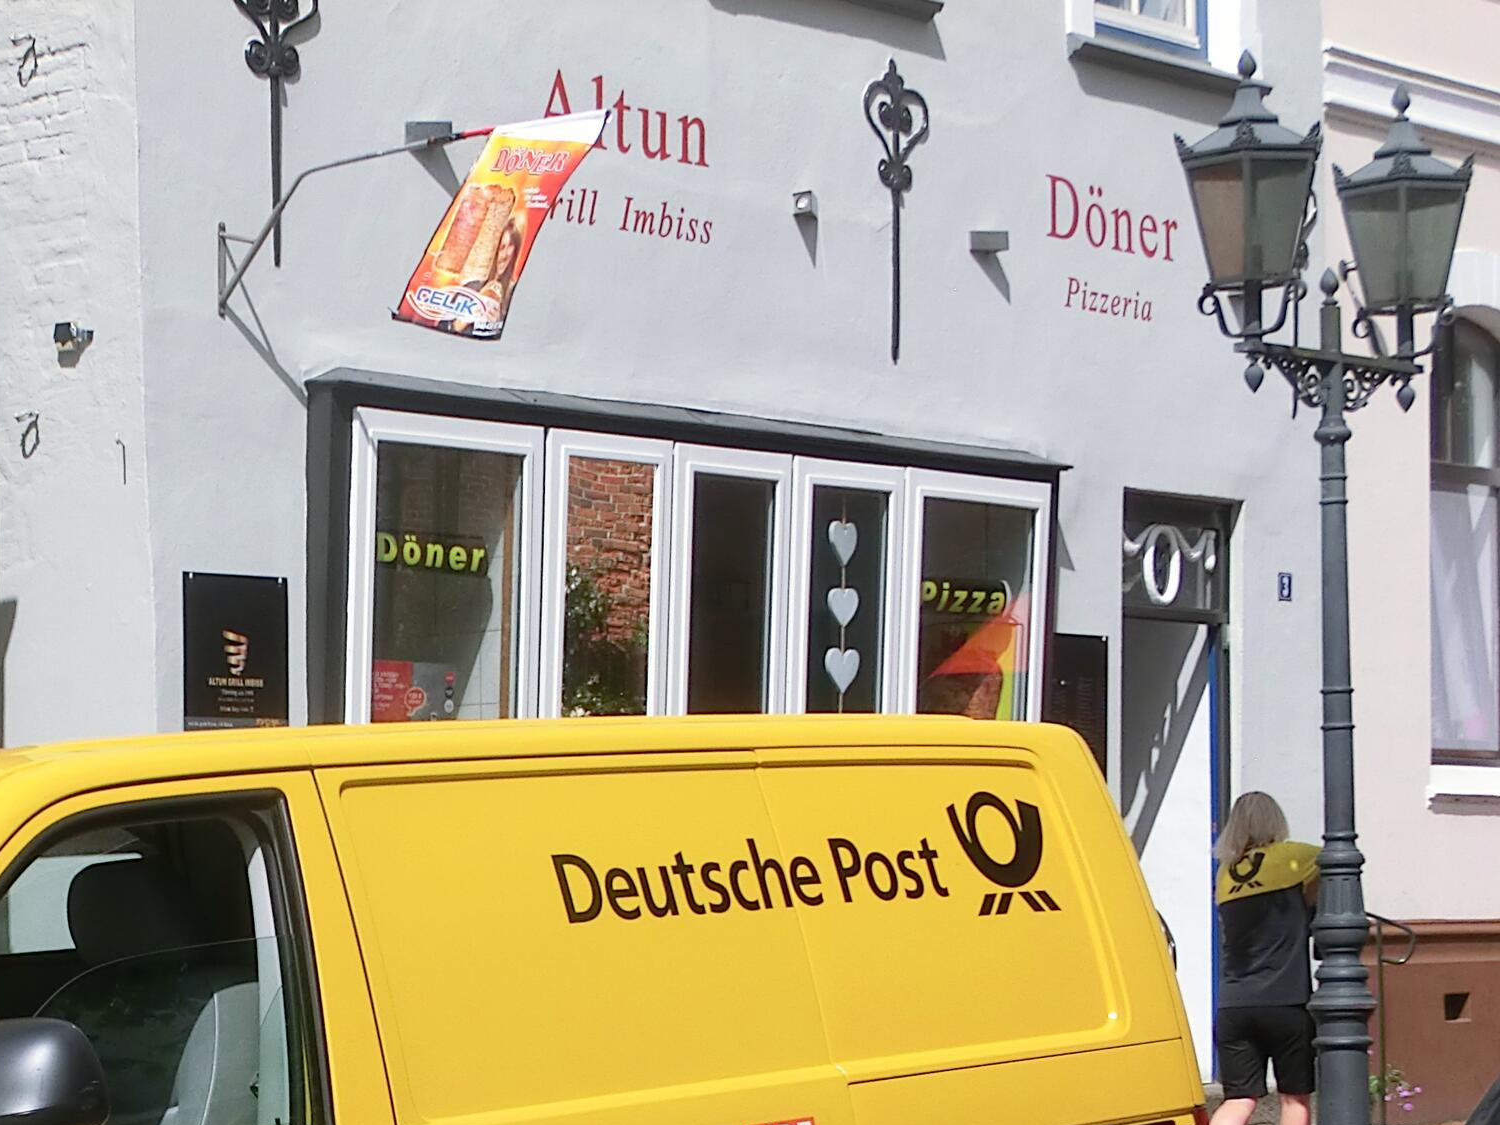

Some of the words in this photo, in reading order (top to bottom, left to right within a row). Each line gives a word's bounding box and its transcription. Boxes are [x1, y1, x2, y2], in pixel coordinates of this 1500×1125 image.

[544, 68, 709, 168] Altun
[550, 188, 598, 226] rill
[619, 196, 713, 245] Imbiss
[1045, 173, 1179, 262] Döner
[1065, 276, 1153, 322] Pizzeria
[377, 532, 485, 572] Döner
[921, 580, 1006, 615] Pizza
[551, 838, 824, 923] Deutsche
[827, 837, 950, 903] Post
